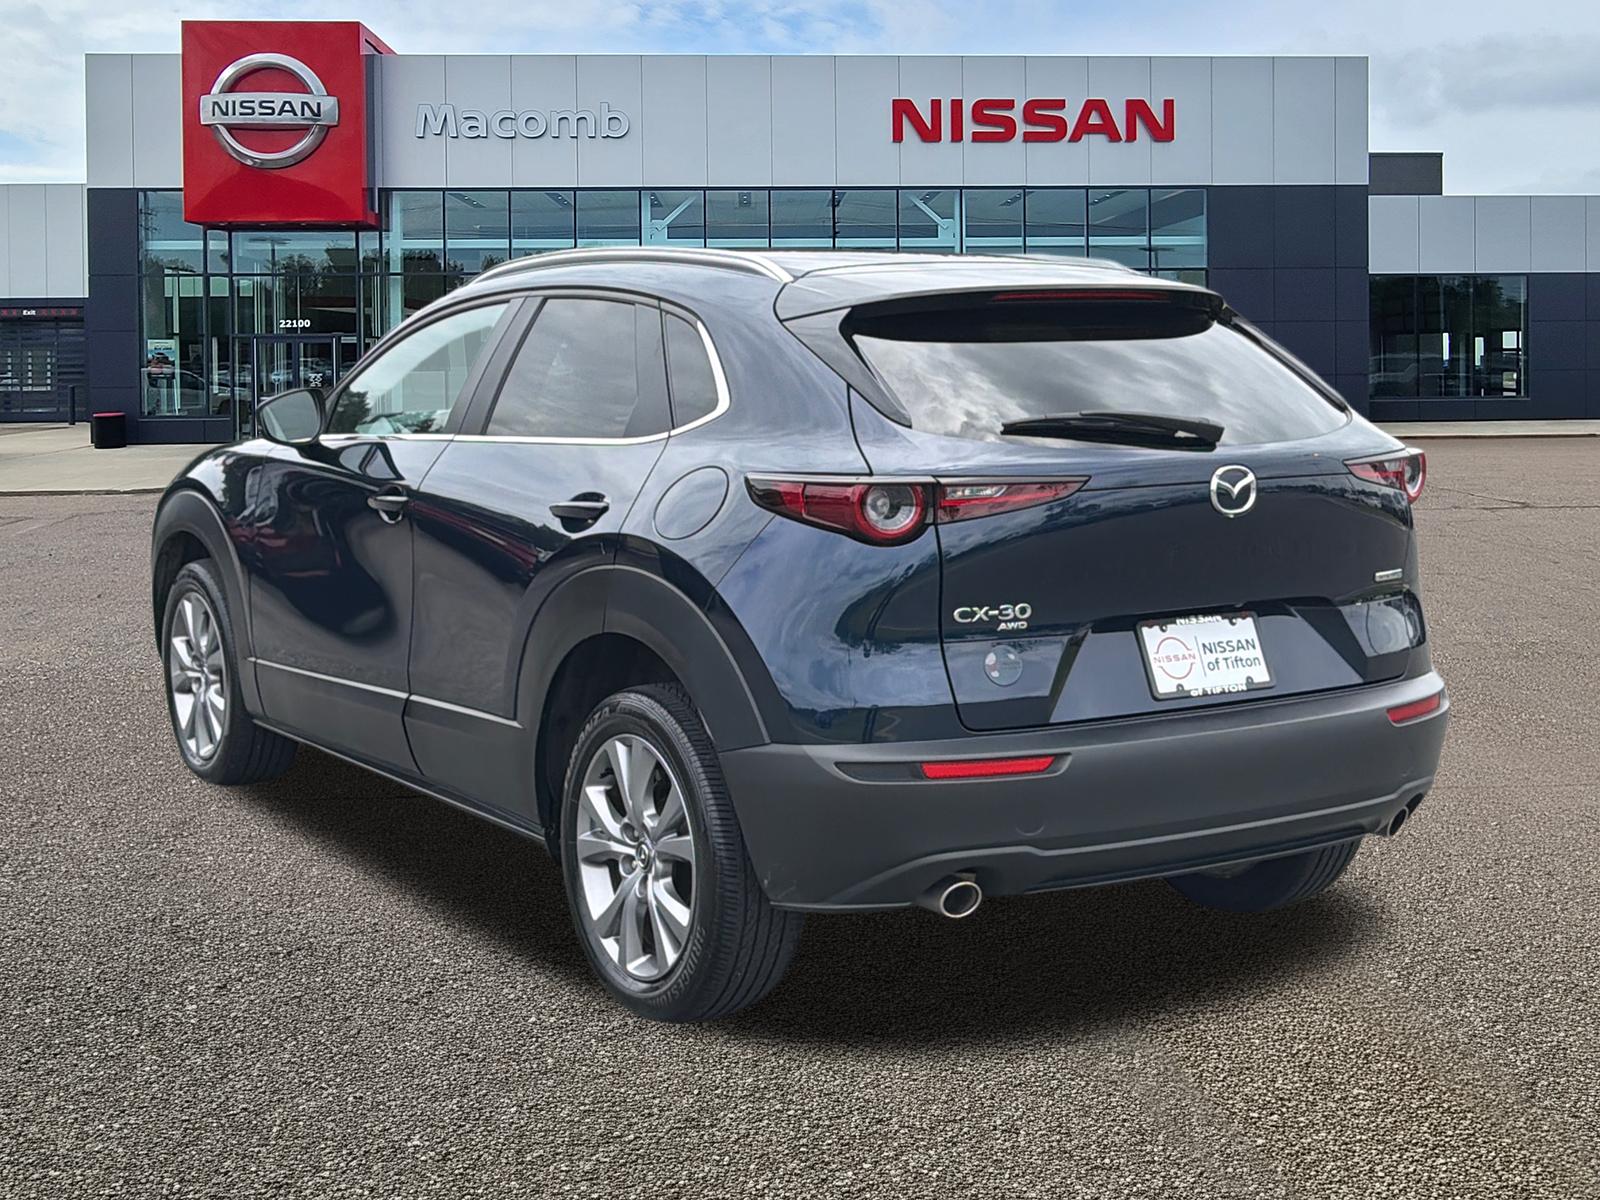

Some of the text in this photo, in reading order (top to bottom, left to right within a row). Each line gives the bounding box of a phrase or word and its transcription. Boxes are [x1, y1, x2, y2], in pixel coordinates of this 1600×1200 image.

[212, 100, 322, 117] NISSAN
[415, 102, 630, 139] Macomb
[892, 98, 1175, 143] NISSAN
[279, 319, 311, 328] 22100
[953, 603, 1032, 623] CX-30
[997, 621, 1028, 632] AWD
[1202, 638, 1256, 655] NISSAN
[1153, 653, 1197, 664] NISSAN
[1207, 655, 1262, 672] of Tifton
[1205, 684, 1248, 695] TIFTON
